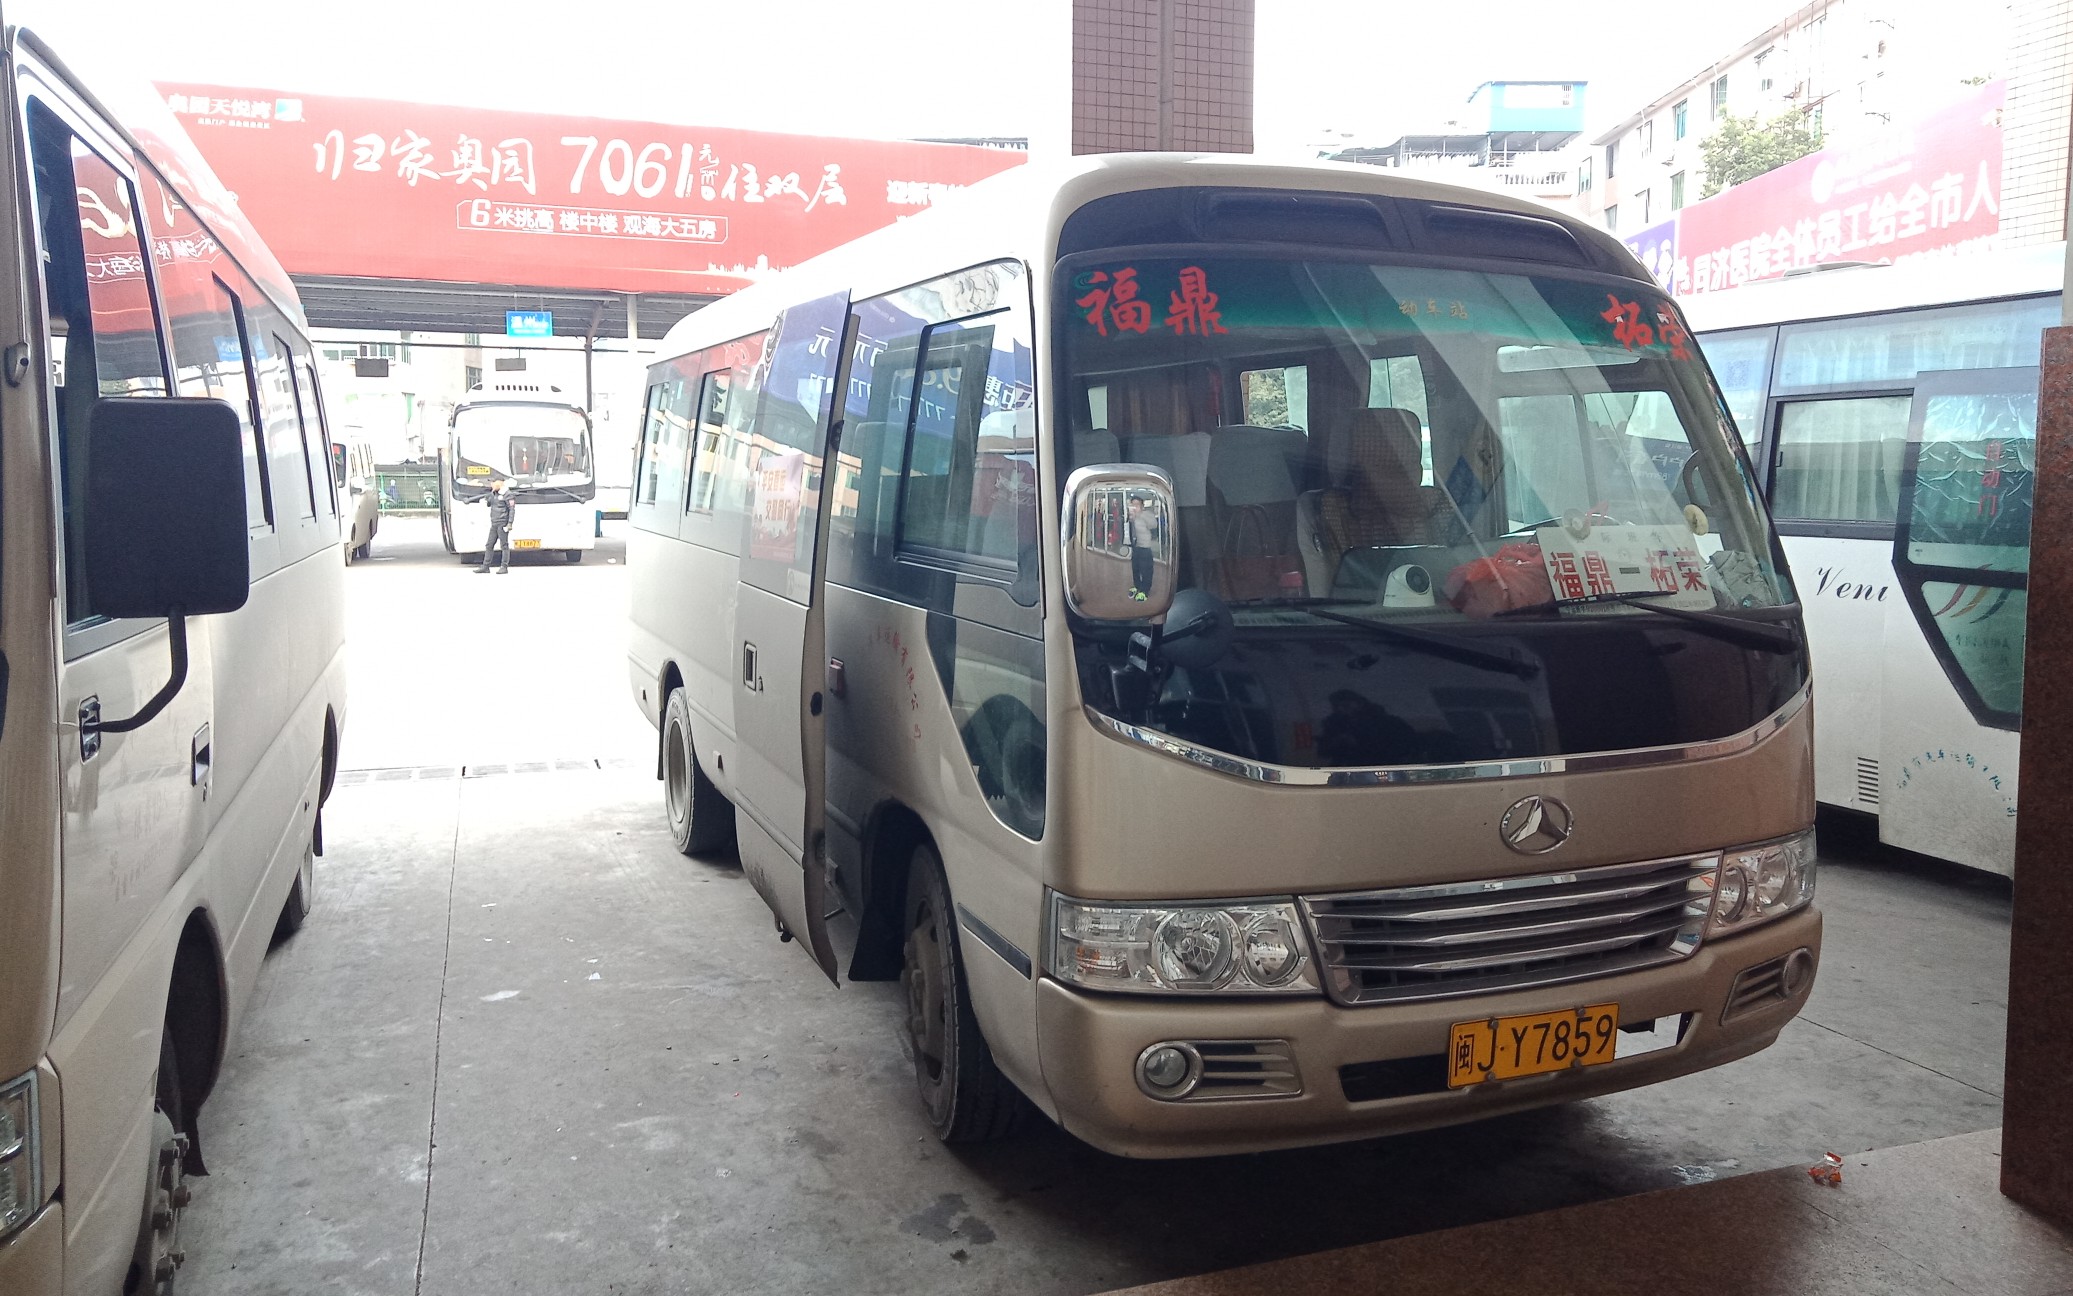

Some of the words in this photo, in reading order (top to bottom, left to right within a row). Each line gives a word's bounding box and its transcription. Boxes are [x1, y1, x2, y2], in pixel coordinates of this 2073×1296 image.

[313, 130, 537, 196] 归家奥园
[559, 211, 619, 235] 楼中楼
[623, 214, 717, 241] 观海大五房
[1075, 266, 1229, 338] 福鼎
[1977, 440, 2003, 517] 自动门
